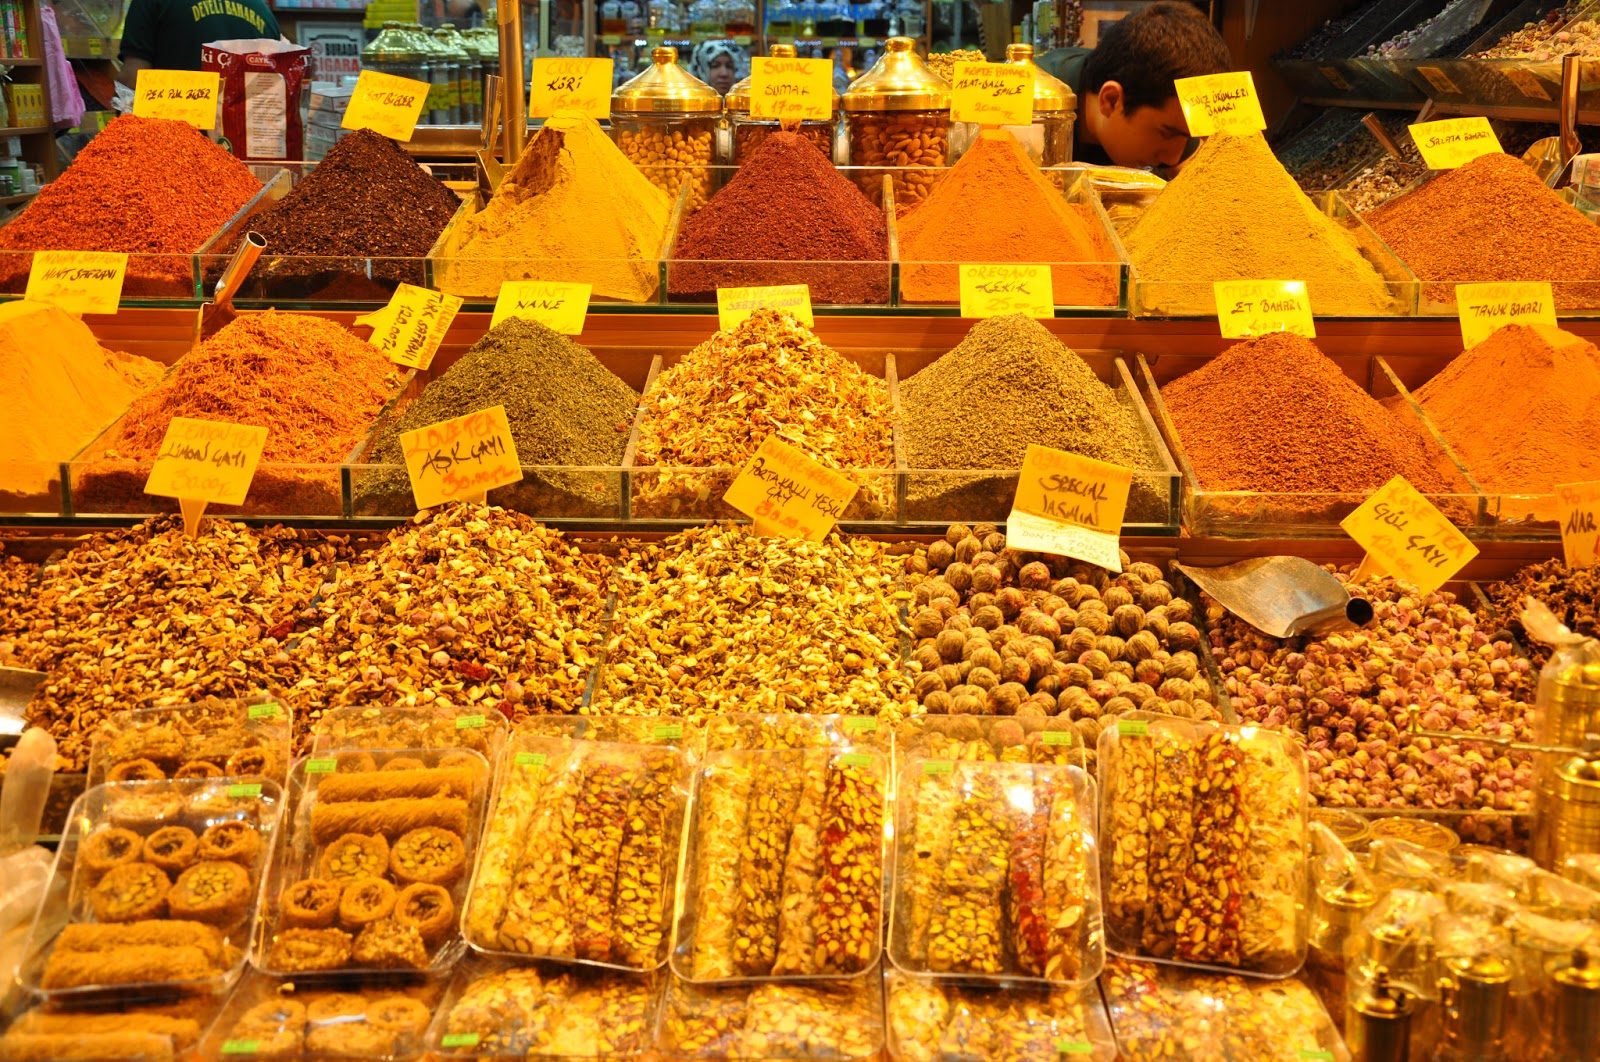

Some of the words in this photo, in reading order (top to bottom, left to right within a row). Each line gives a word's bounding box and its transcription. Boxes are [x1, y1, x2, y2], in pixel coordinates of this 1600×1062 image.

[225, 0, 266, 35] BAHARAT
[763, 60, 815, 75] SUMAC
[764, 84, 811, 97] SUMAK
[992, 85, 1025, 97] SPICE
[1425, 136, 1462, 149] SALATA
[967, 266, 1037, 281] OREGANO
[514, 299, 566, 311] NANE
[1231, 301, 1255, 315] ET
[1260, 299, 1303, 314] BAHARI
[1509, 301, 1543, 318] BAHARI
[407, 422, 463, 460] LOVE
[462, 413, 506, 440] TEA
[1038, 473, 1108, 502] SPECIAL
[1564, 508, 1598, 537] NAR
[1373, 502, 1409, 532] GÜL
[1405, 534, 1449, 569] ÇAYI
[1432, 522, 1468, 560] TEA
